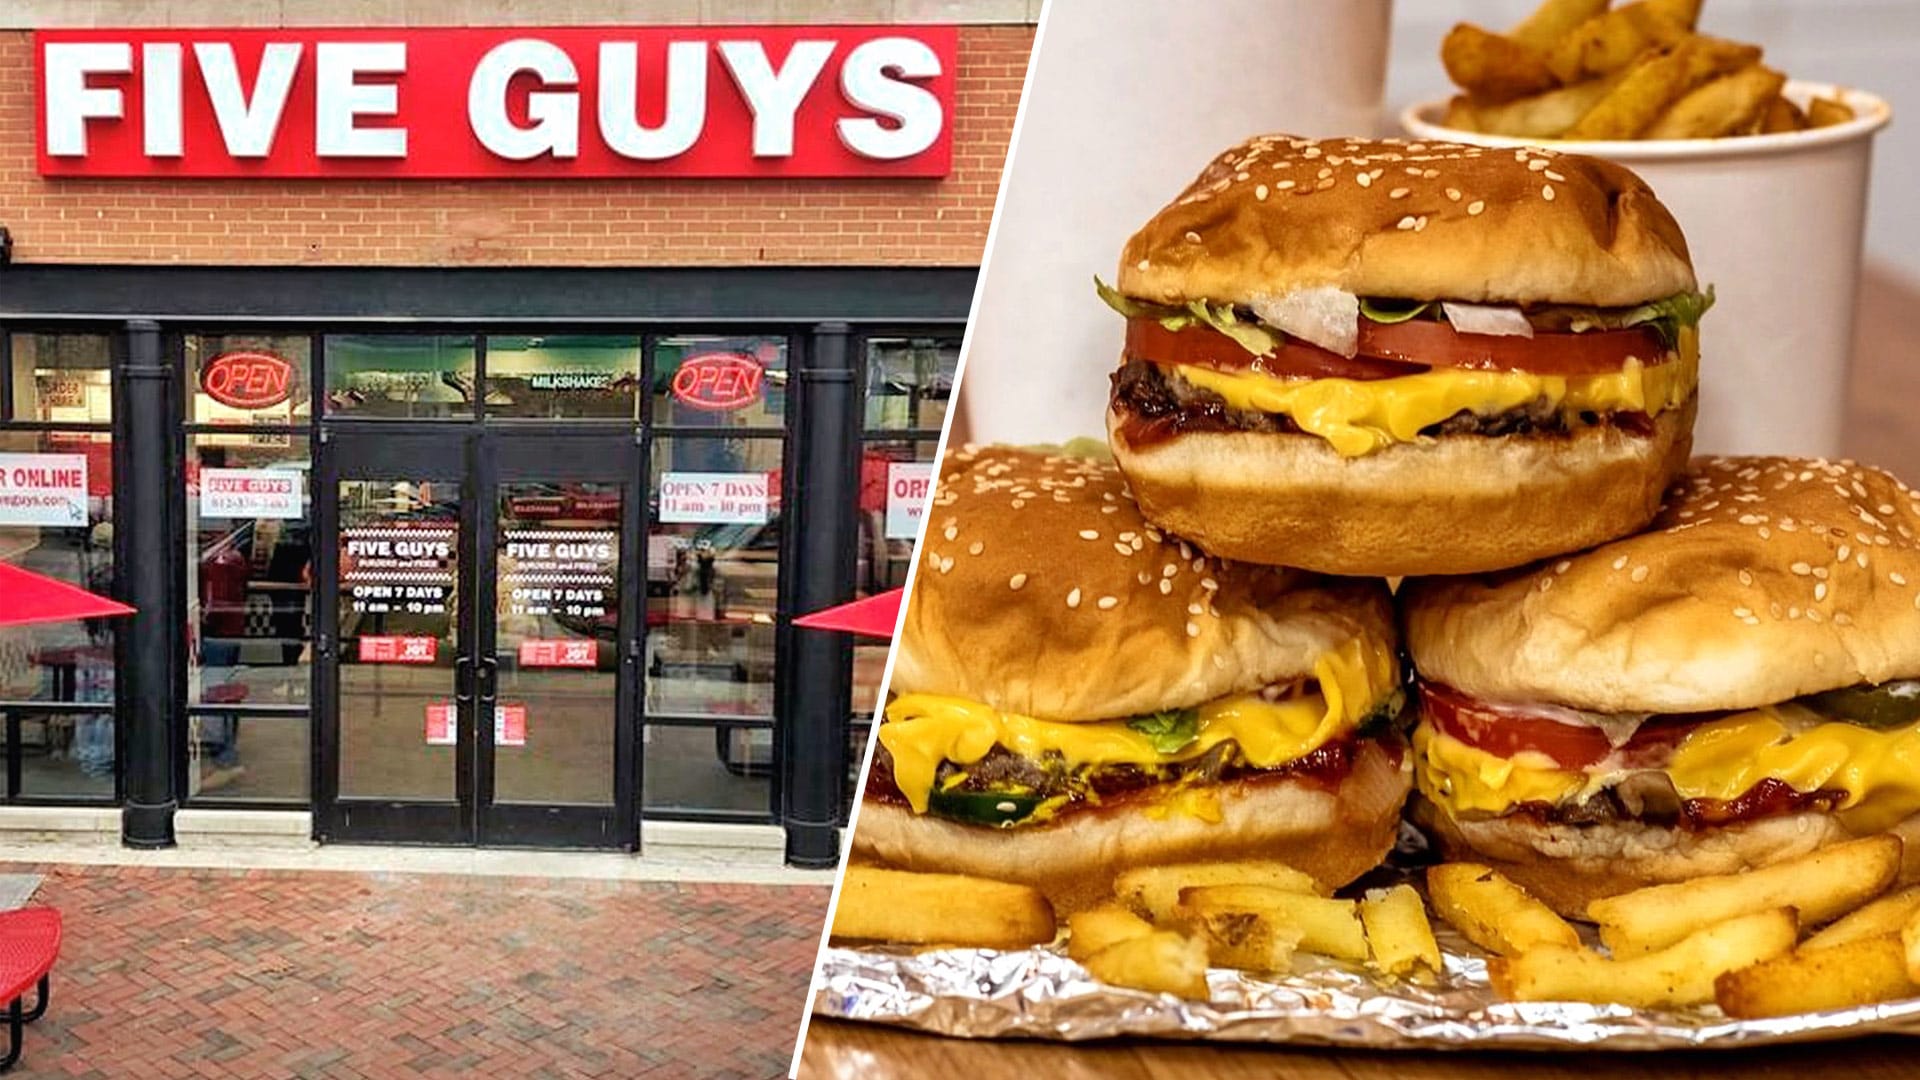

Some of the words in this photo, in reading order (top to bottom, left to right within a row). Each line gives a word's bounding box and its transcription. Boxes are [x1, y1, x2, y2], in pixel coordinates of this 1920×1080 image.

[43, 41, 408, 159] FIVE
[467, 37, 944, 161] GUYS
[207, 364, 291, 393] OPEN
[673, 366, 763, 397] OPEN
[13, 468, 82, 488] ONLINE
[208, 478, 242, 492] FIVE
[248, 479, 291, 493] GUYS
[663, 482, 708, 496] OPEN
[711, 482, 721, 496] 7
[725, 483, 765, 496] DAYS
[664, 499, 677, 512] 11
[681, 502, 705, 512] am
[720, 501, 735, 512] 10
[738, 502, 762, 516] pm
[347, 541, 391, 556] FIVE
[394, 541, 450, 557] GUYS
[507, 543, 551, 558] FIVE
[555, 543, 610, 560] GUYS
[353, 586, 393, 598] OPEN
[395, 586, 404, 598] 7
[406, 586, 443, 598] DAYS
[512, 588, 552, 601] OPEN
[553, 589, 563, 601] 7
[565, 589, 603, 601] DAYS
[353, 601, 366, 612] 11
[368, 603, 390, 613] am
[407, 602, 423, 613] 10
[424, 604, 445, 615] pm
[512, 604, 524, 616] 11
[526, 606, 548, 616] am
[566, 604, 582, 616] 10
[583, 606, 606, 618] pm
